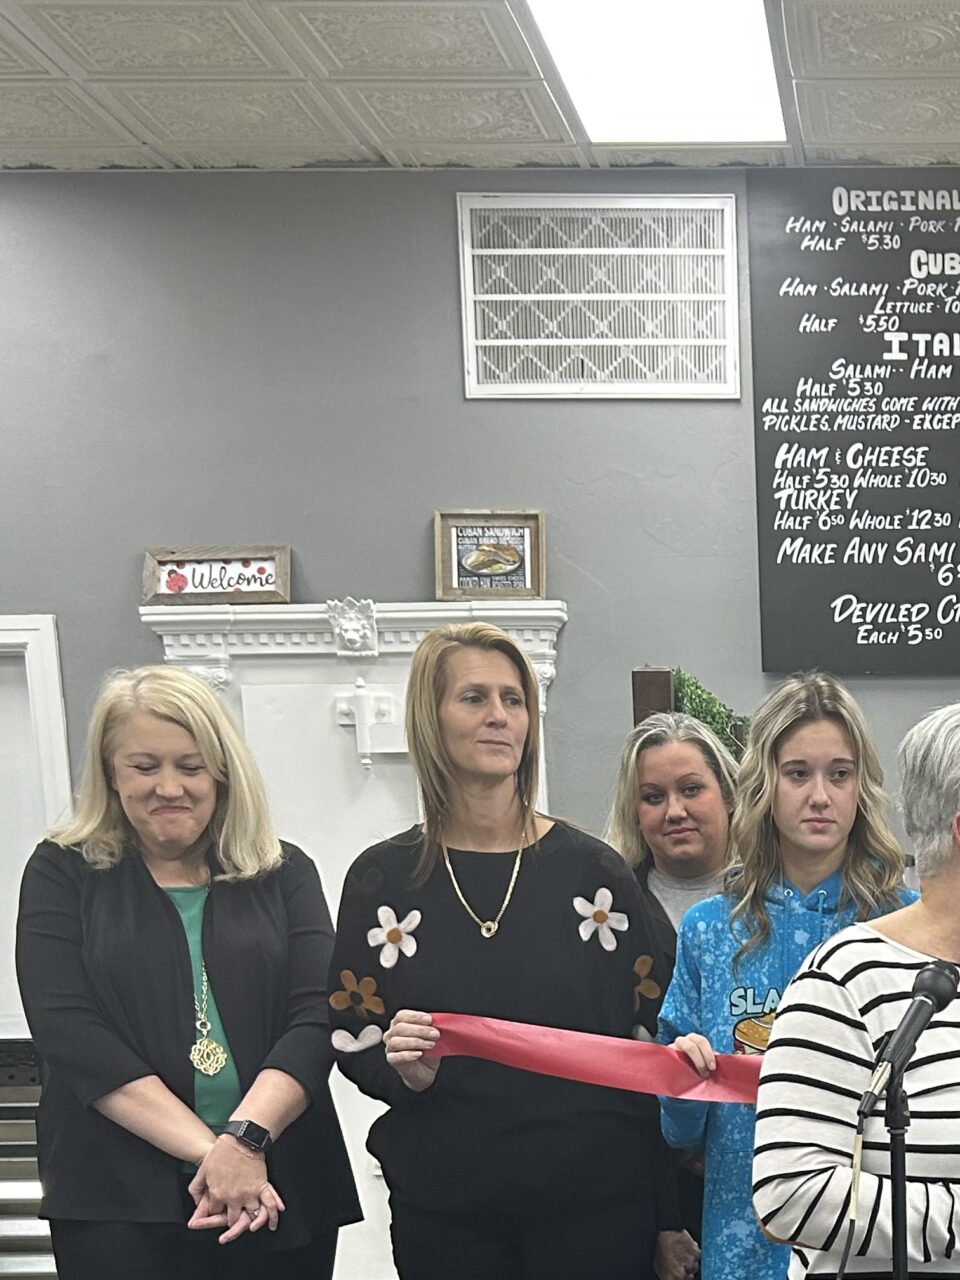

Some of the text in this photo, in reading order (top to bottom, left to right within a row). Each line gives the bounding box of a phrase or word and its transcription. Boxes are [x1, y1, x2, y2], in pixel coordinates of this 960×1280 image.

[785, 217, 824, 233] HAM
[840, 217, 894, 232] SALAMI
[909, 217, 944, 232] PORK
[801, 236, 845, 251] HALF
[779, 278, 816, 296] HAM
[829, 278, 887, 296] SALAMI
[902, 279, 947, 297] PORK
[874, 297, 932, 315] LETTUCE
[799, 316, 837, 332] HALF
[829, 358, 892, 379] SALAMI
[910, 360, 952, 379] HAM
[796, 380, 835, 397] HALF
[762, 398, 788, 413] ALL
[793, 398, 876, 412] SANDWICHES
[882, 397, 915, 412] COME
[922, 396, 958, 411] WITH
[834, 415, 899, 431] MUSTARD
[775, 442, 929, 469] HAM CHEESE
[774, 488, 858, 510] TURKEY
[777, 536, 837, 564] MAKE
[843, 536, 888, 563] ANY
[893, 536, 955, 565] SAMI
[192, 563, 276, 591] Welcome
[830, 594, 930, 624] DEVILED
